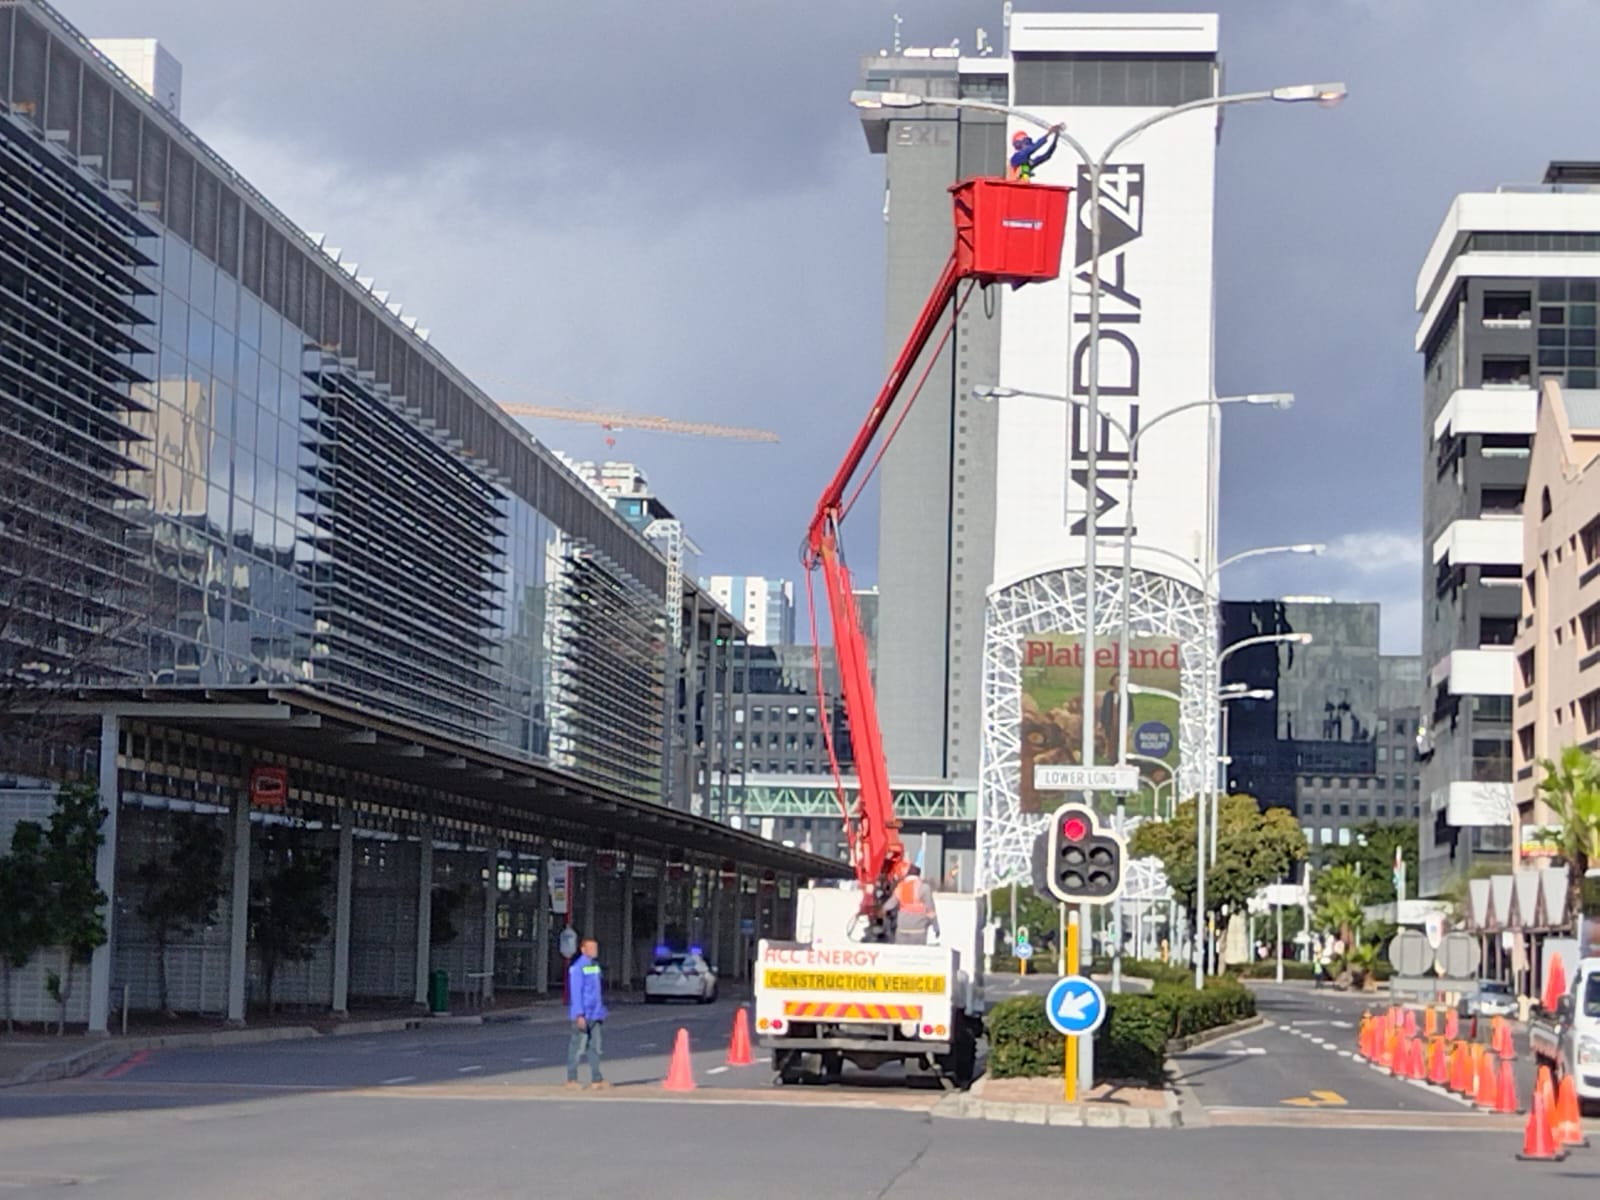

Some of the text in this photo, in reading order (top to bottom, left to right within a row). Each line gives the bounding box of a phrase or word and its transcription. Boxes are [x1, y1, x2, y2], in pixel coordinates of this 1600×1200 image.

[1025, 640, 1180, 669] Plateland
[1045, 771, 1085, 785] LOWER
[1088, 772, 1117, 785] LONG
[807, 949, 879, 966] ENERGY
[769, 971, 942, 993] CONSTRUCTION VEHICLE
